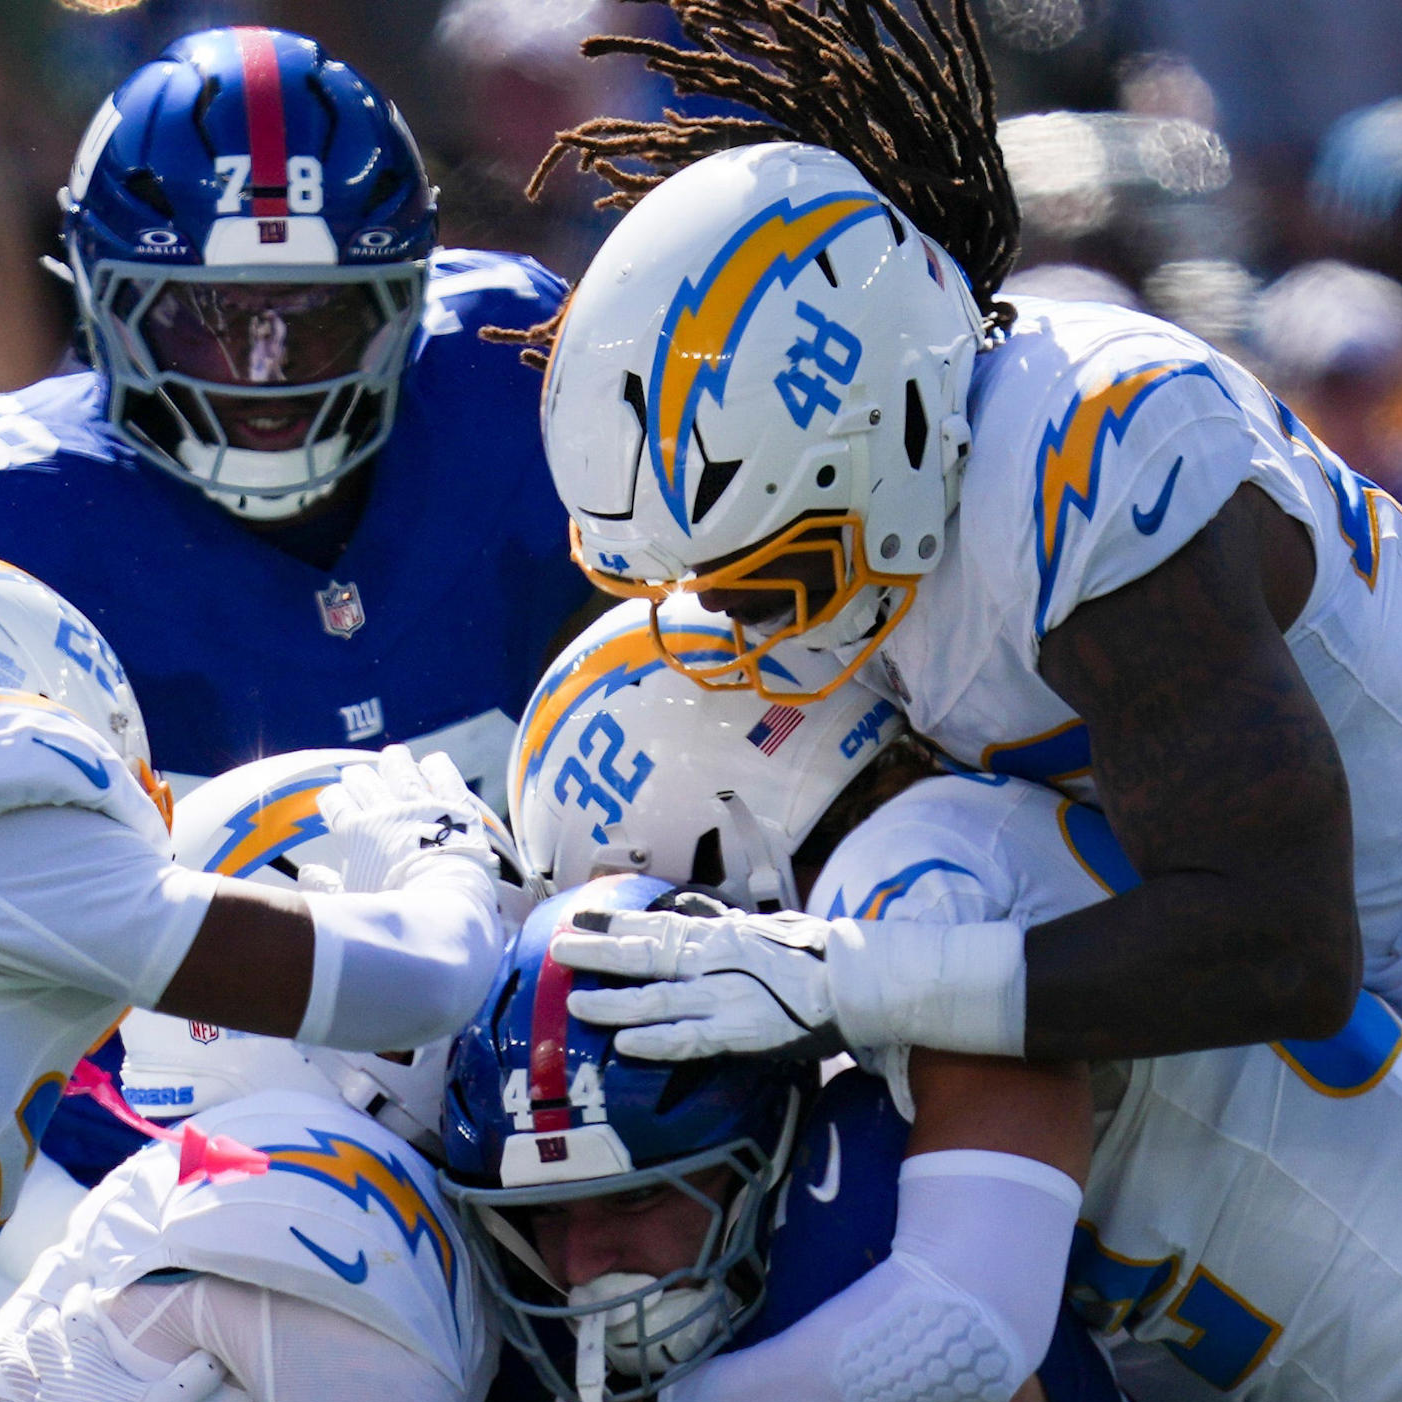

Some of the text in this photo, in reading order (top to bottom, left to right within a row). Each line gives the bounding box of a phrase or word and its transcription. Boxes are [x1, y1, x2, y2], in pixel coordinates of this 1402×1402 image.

[215, 154, 324, 214] 78
[554, 709, 655, 845] 32
[191, 1020, 217, 1041] NFL
[503, 1062, 608, 1130] 44
